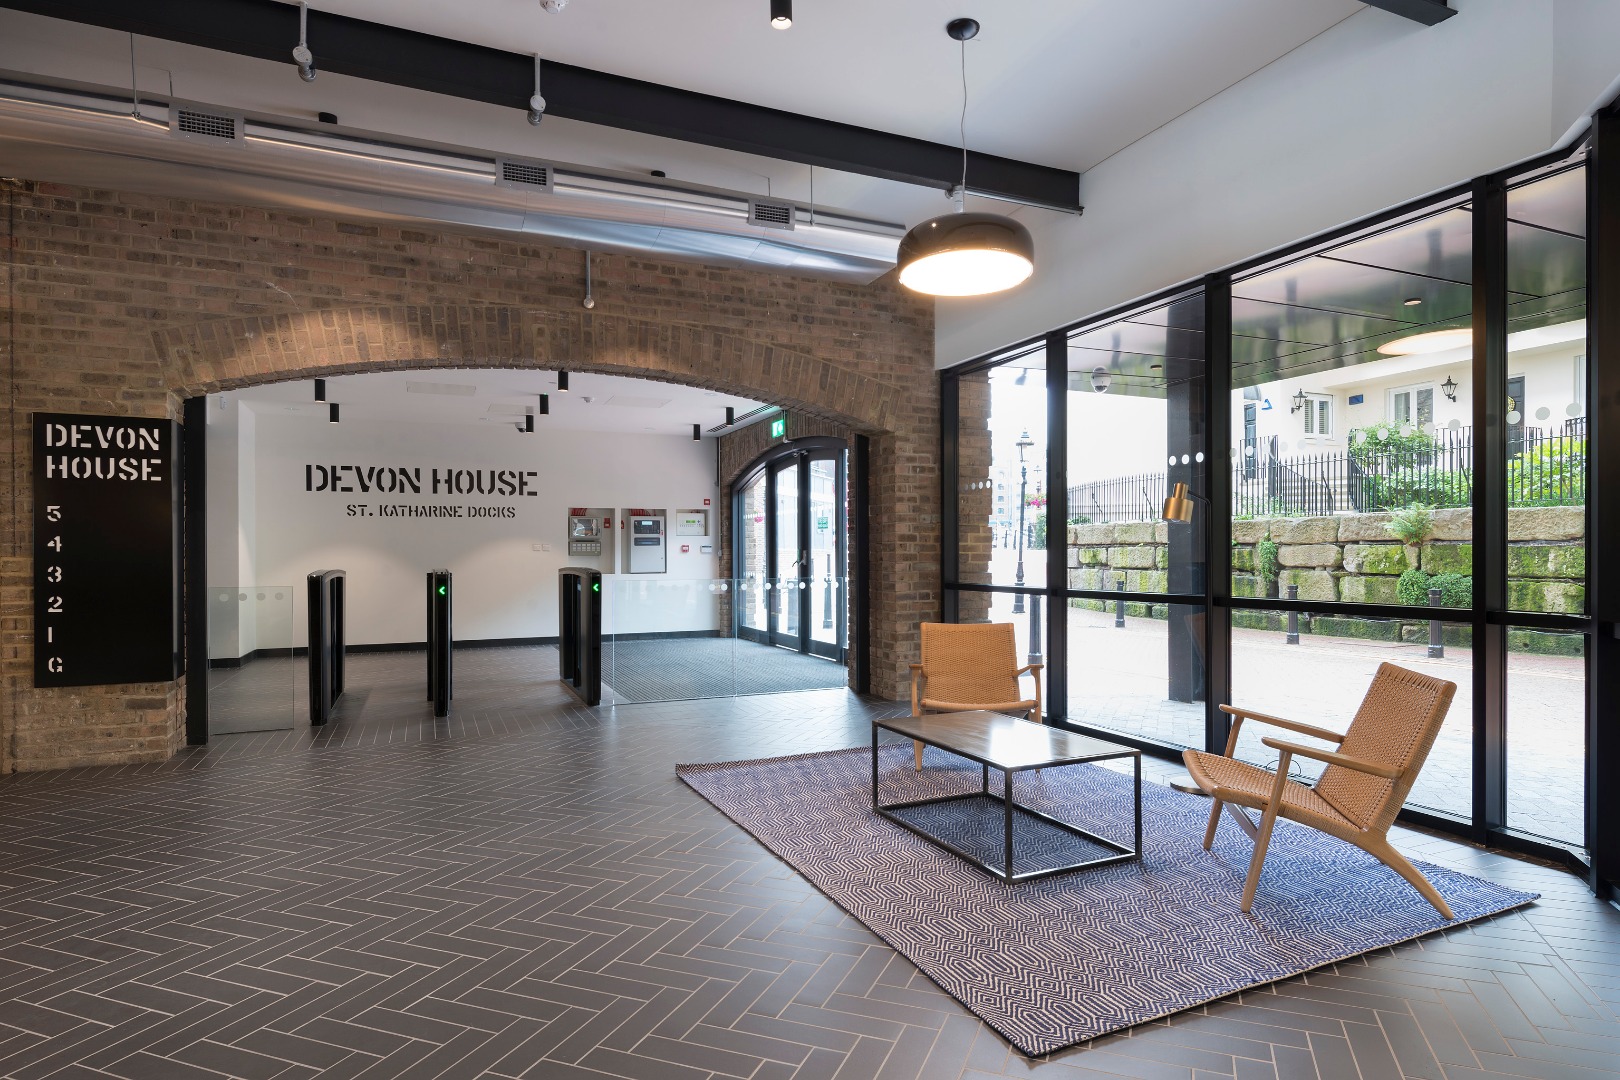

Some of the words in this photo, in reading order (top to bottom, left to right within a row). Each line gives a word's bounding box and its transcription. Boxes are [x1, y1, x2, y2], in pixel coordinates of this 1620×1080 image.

[46, 423, 160, 451] DEVON
[46, 455, 162, 482] HOUSE
[305, 464, 421, 494] DEVON
[431, 468, 538, 497] HOUSE
[46, 505, 62, 522] 5
[346, 504, 374, 517] ST.
[379, 504, 463, 518] KATHARINE
[467, 506, 516, 519] DOCKS
[47, 535, 62, 552] 4
[47, 566, 63, 583] 3
[47, 596, 63, 613] 2
[48, 657, 63, 673] G
